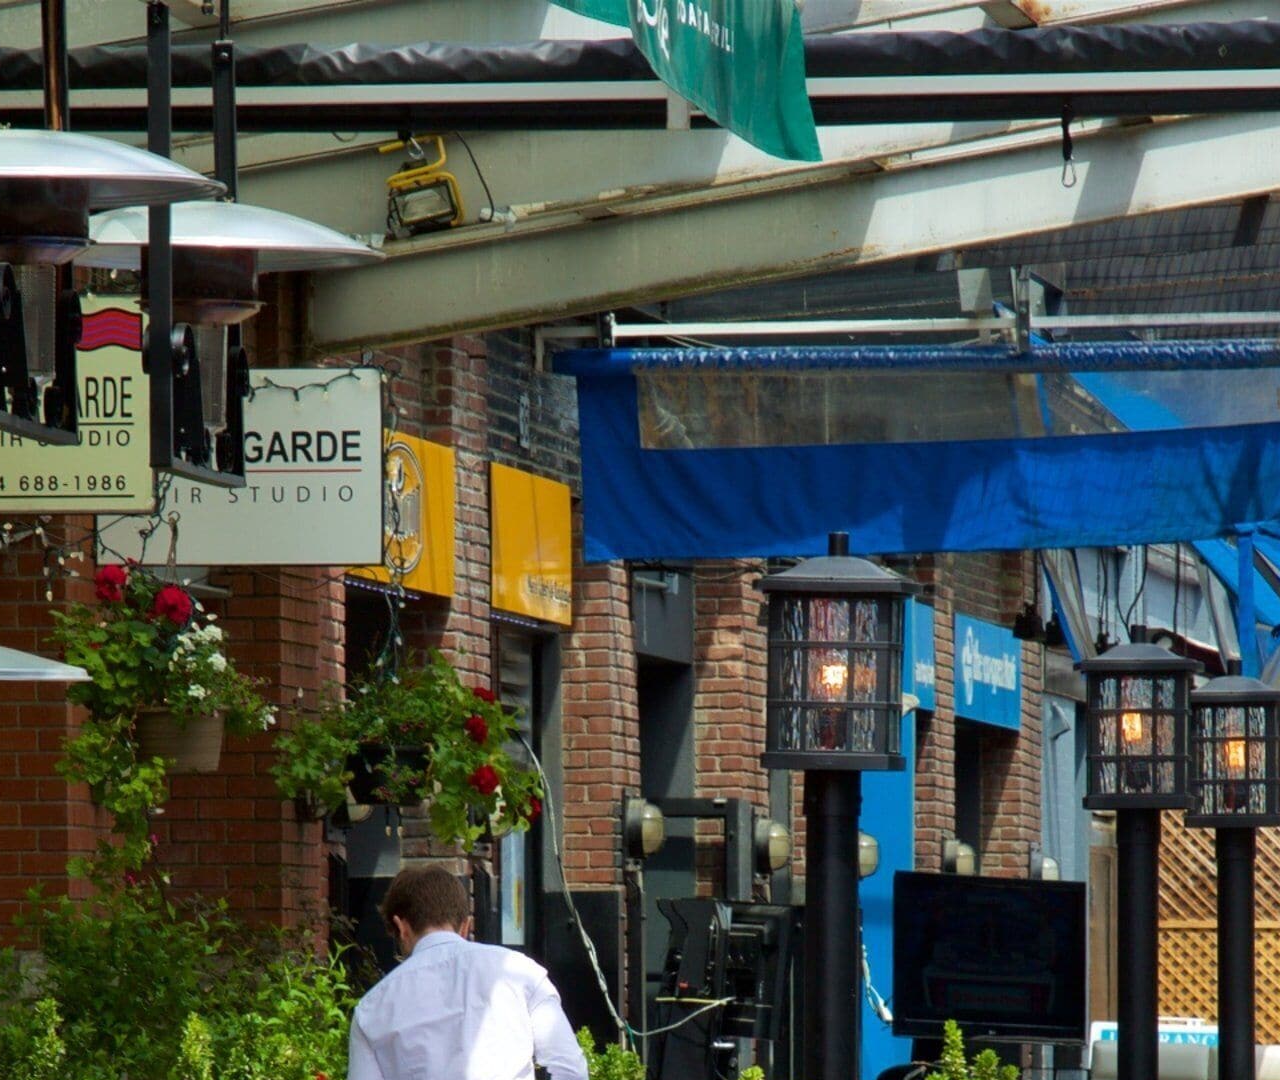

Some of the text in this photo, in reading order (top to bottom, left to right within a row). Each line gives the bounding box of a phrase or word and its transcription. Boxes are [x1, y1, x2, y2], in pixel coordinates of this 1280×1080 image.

[244, 430, 361, 463] GARDE
[19, 475, 126, 491] 688-1986
[228, 485, 354, 503] STUDIO
